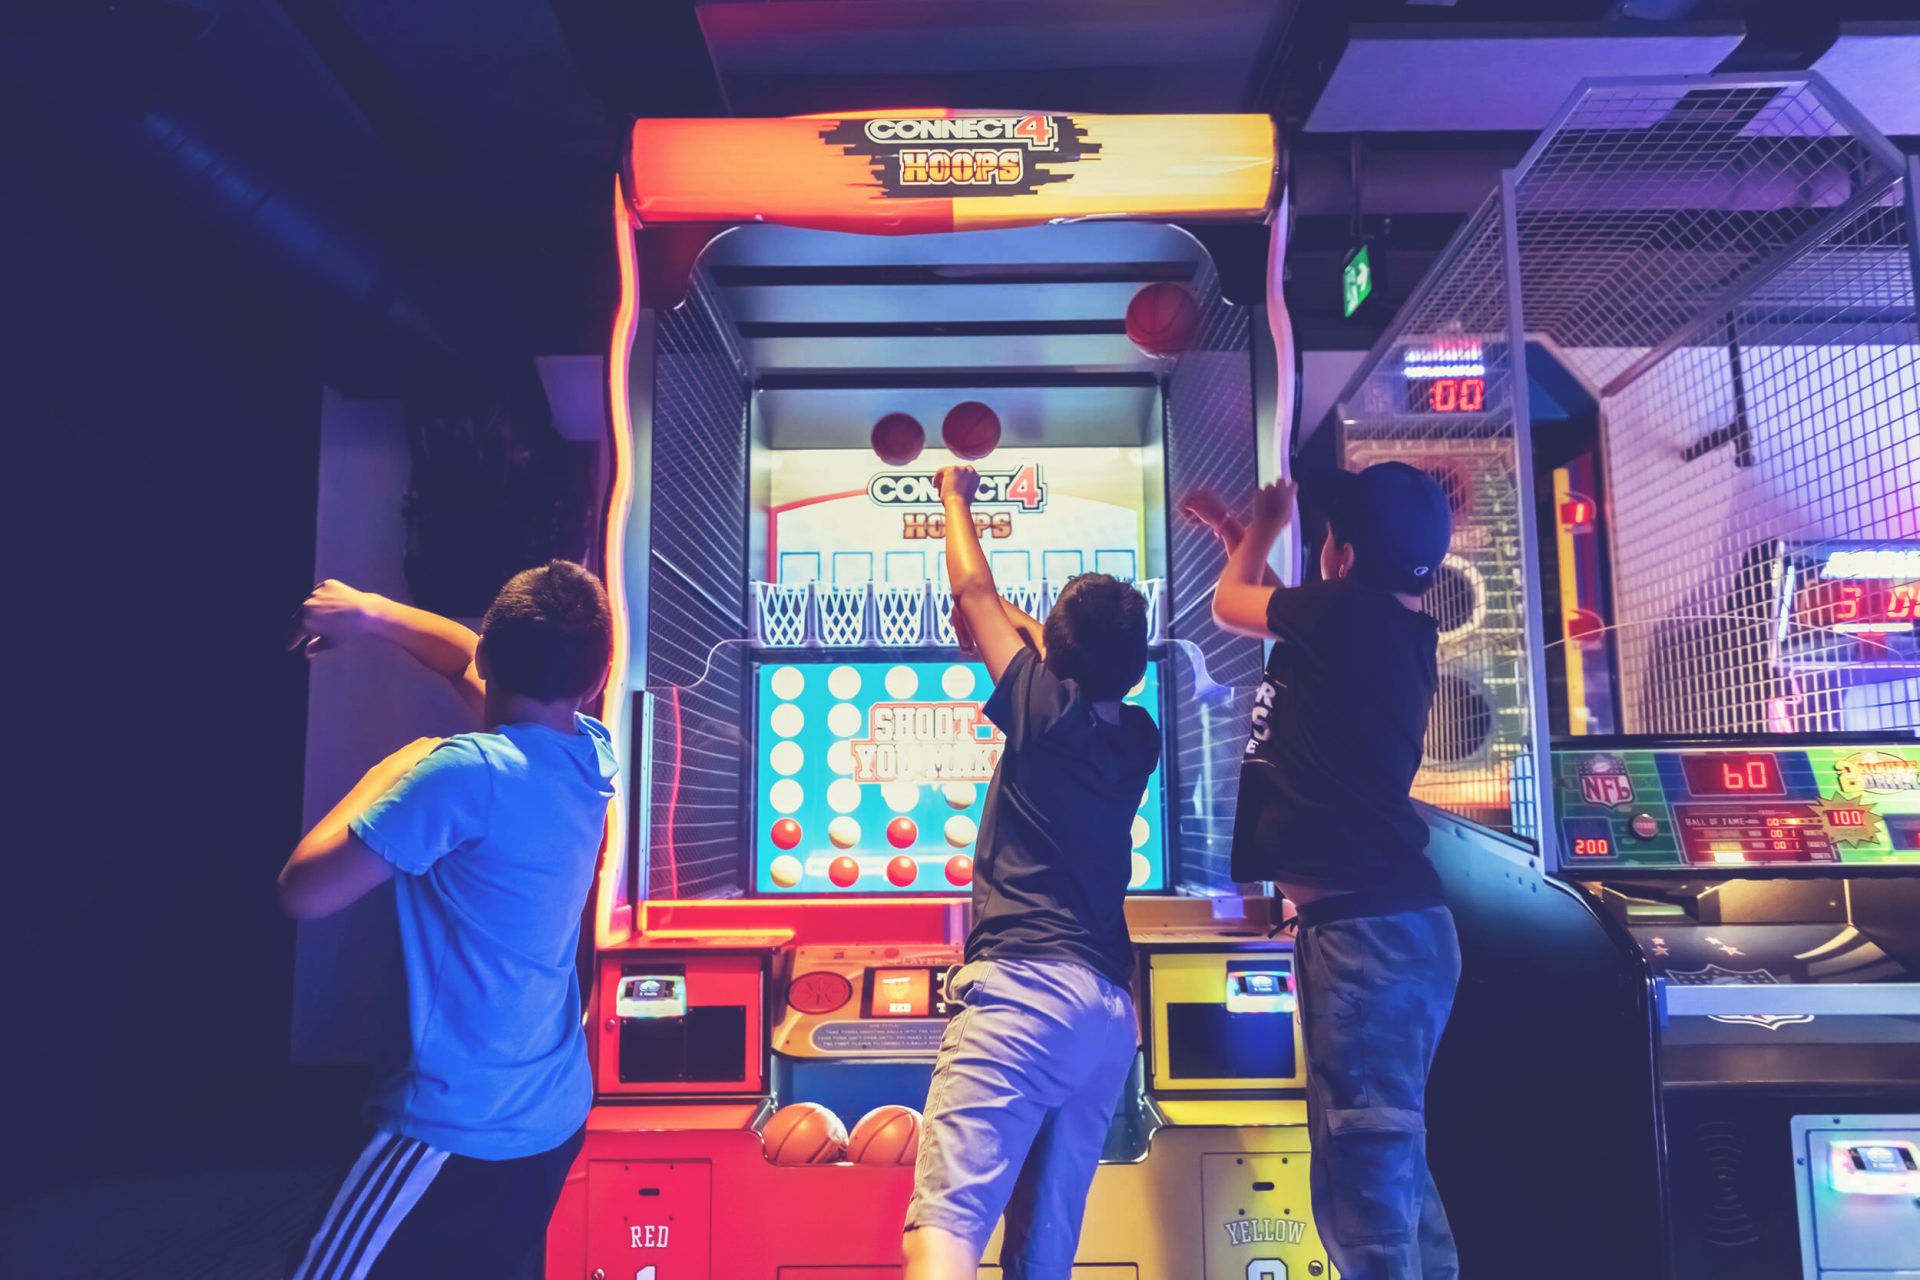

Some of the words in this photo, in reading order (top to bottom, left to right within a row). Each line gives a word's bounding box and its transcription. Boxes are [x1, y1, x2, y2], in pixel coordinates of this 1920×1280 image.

[869, 119, 1019, 140] CONNECT
[1015, 114, 1050, 144] 4
[902, 151, 1021, 183] HOOPS
[871, 475, 1010, 502] CONCT
[902, 512, 1013, 540] HOPS
[873, 705, 977, 743] SHOOT
[1580, 774, 1632, 802] NFL
[1832, 810, 1862, 825] 100
[1574, 838, 1609, 855] 200
[630, 1224, 669, 1248] RED
[1225, 1218, 1306, 1245] YELLOW
